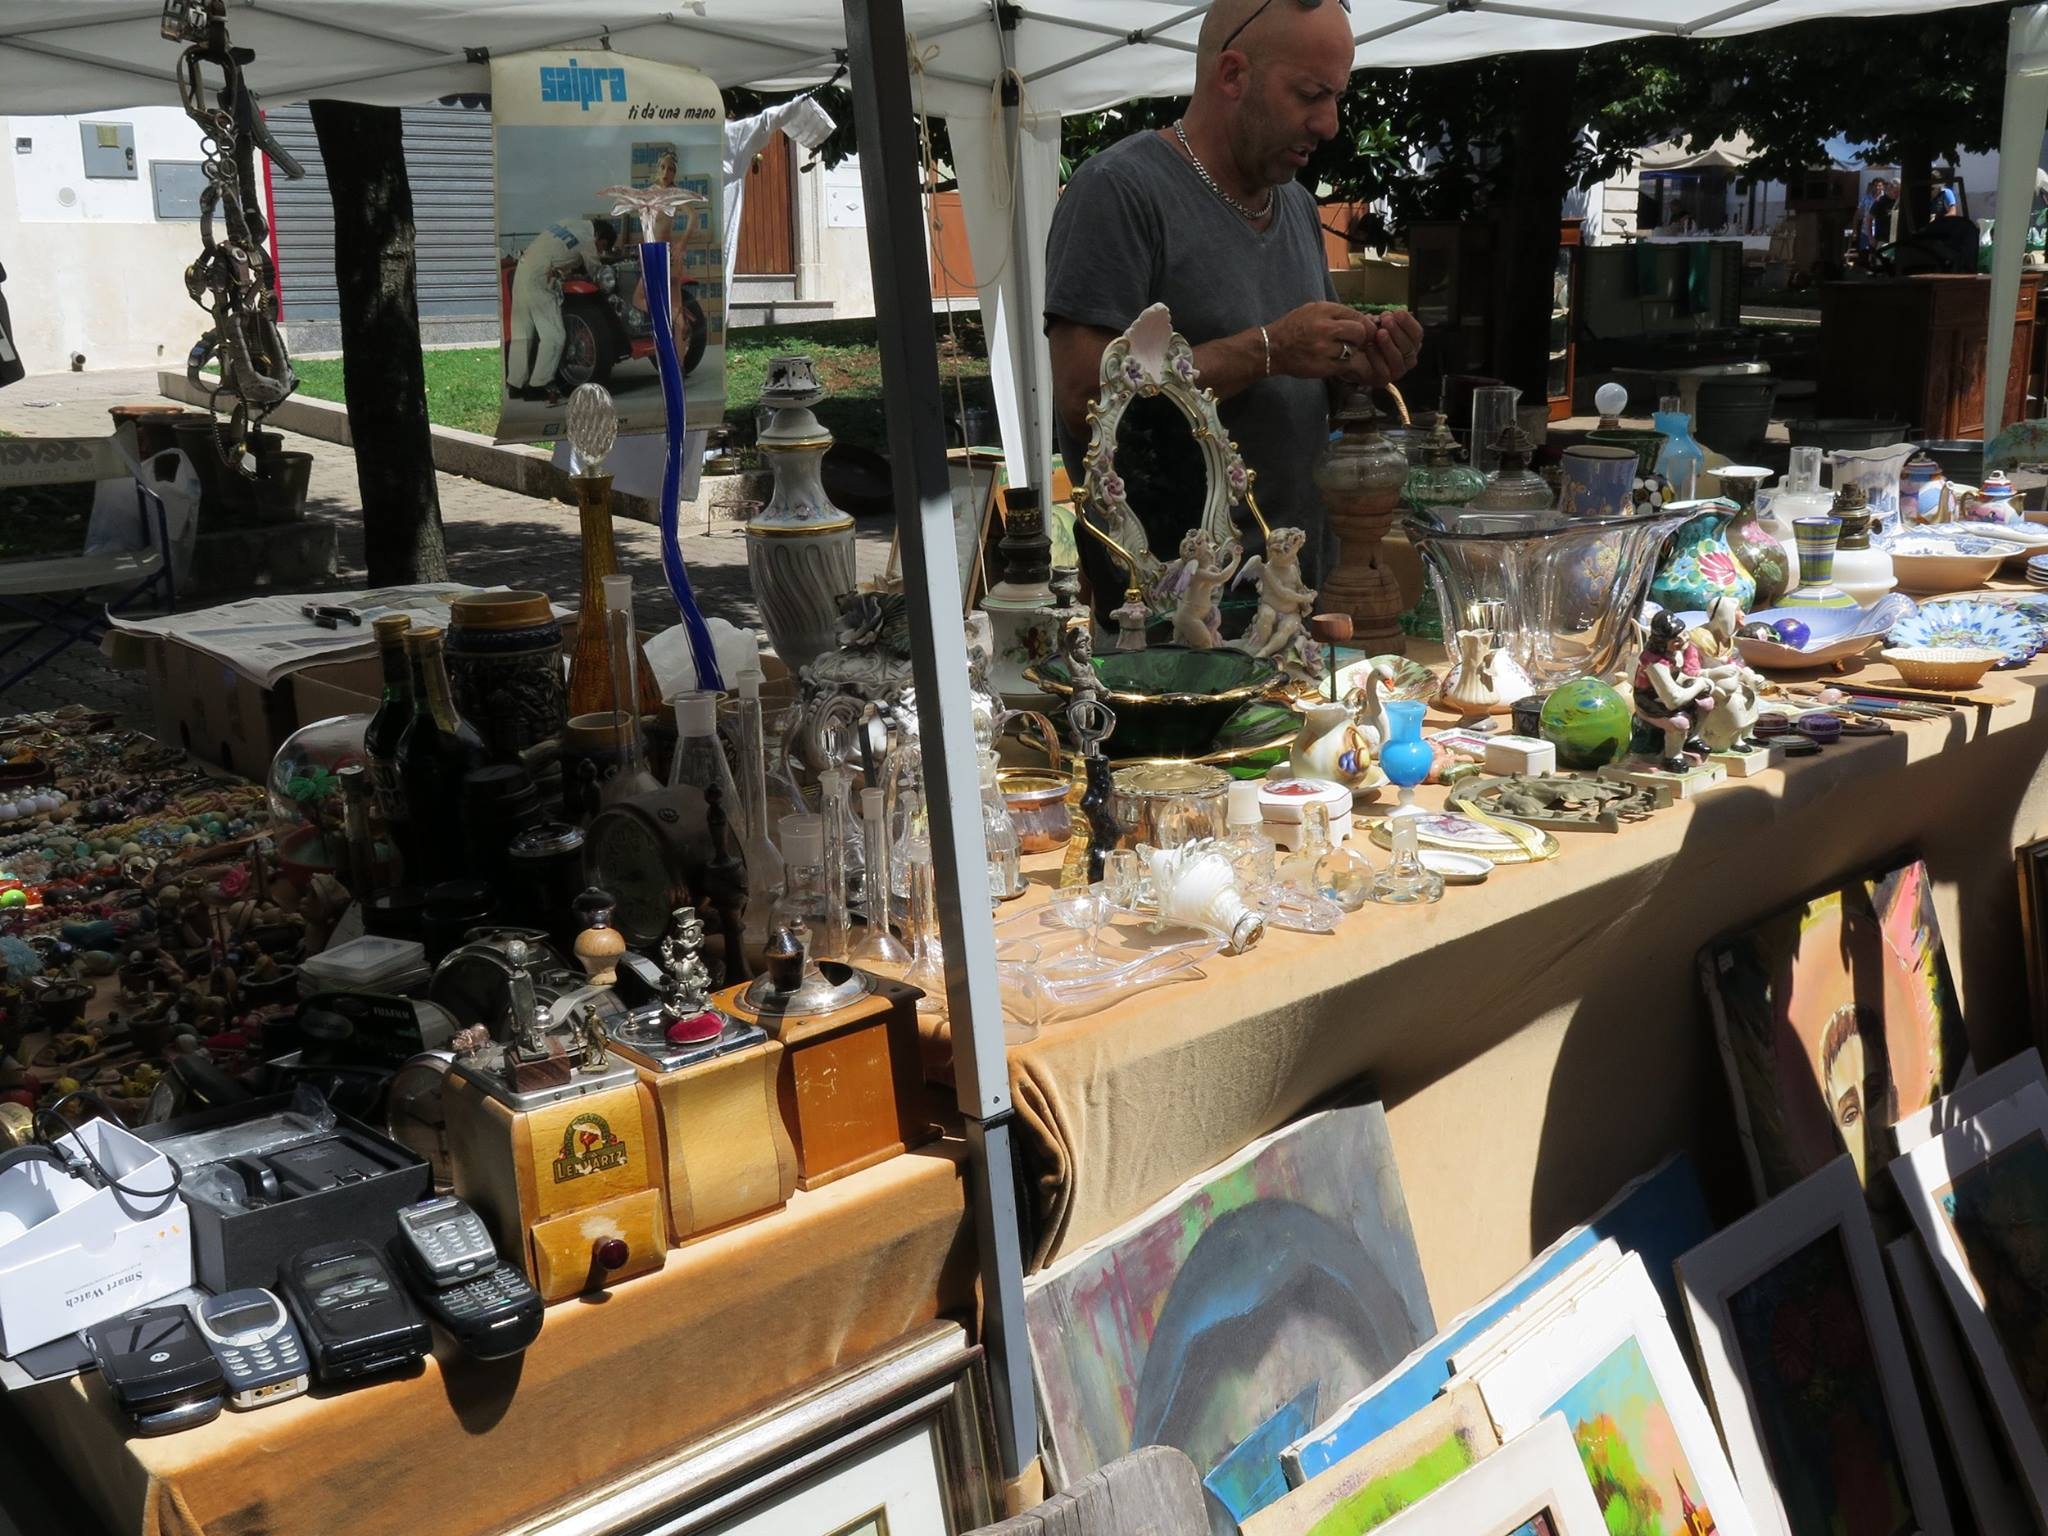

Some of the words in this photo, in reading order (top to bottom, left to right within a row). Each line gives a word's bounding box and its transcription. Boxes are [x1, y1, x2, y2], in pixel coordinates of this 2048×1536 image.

[540, 58, 627, 111] saipra
[628, 104, 640, 120] ti
[659, 107, 680, 119] una
[684, 107, 716, 119] mano
[107, 1271, 143, 1291] Smart
[65, 1288, 104, 1307] Watch
